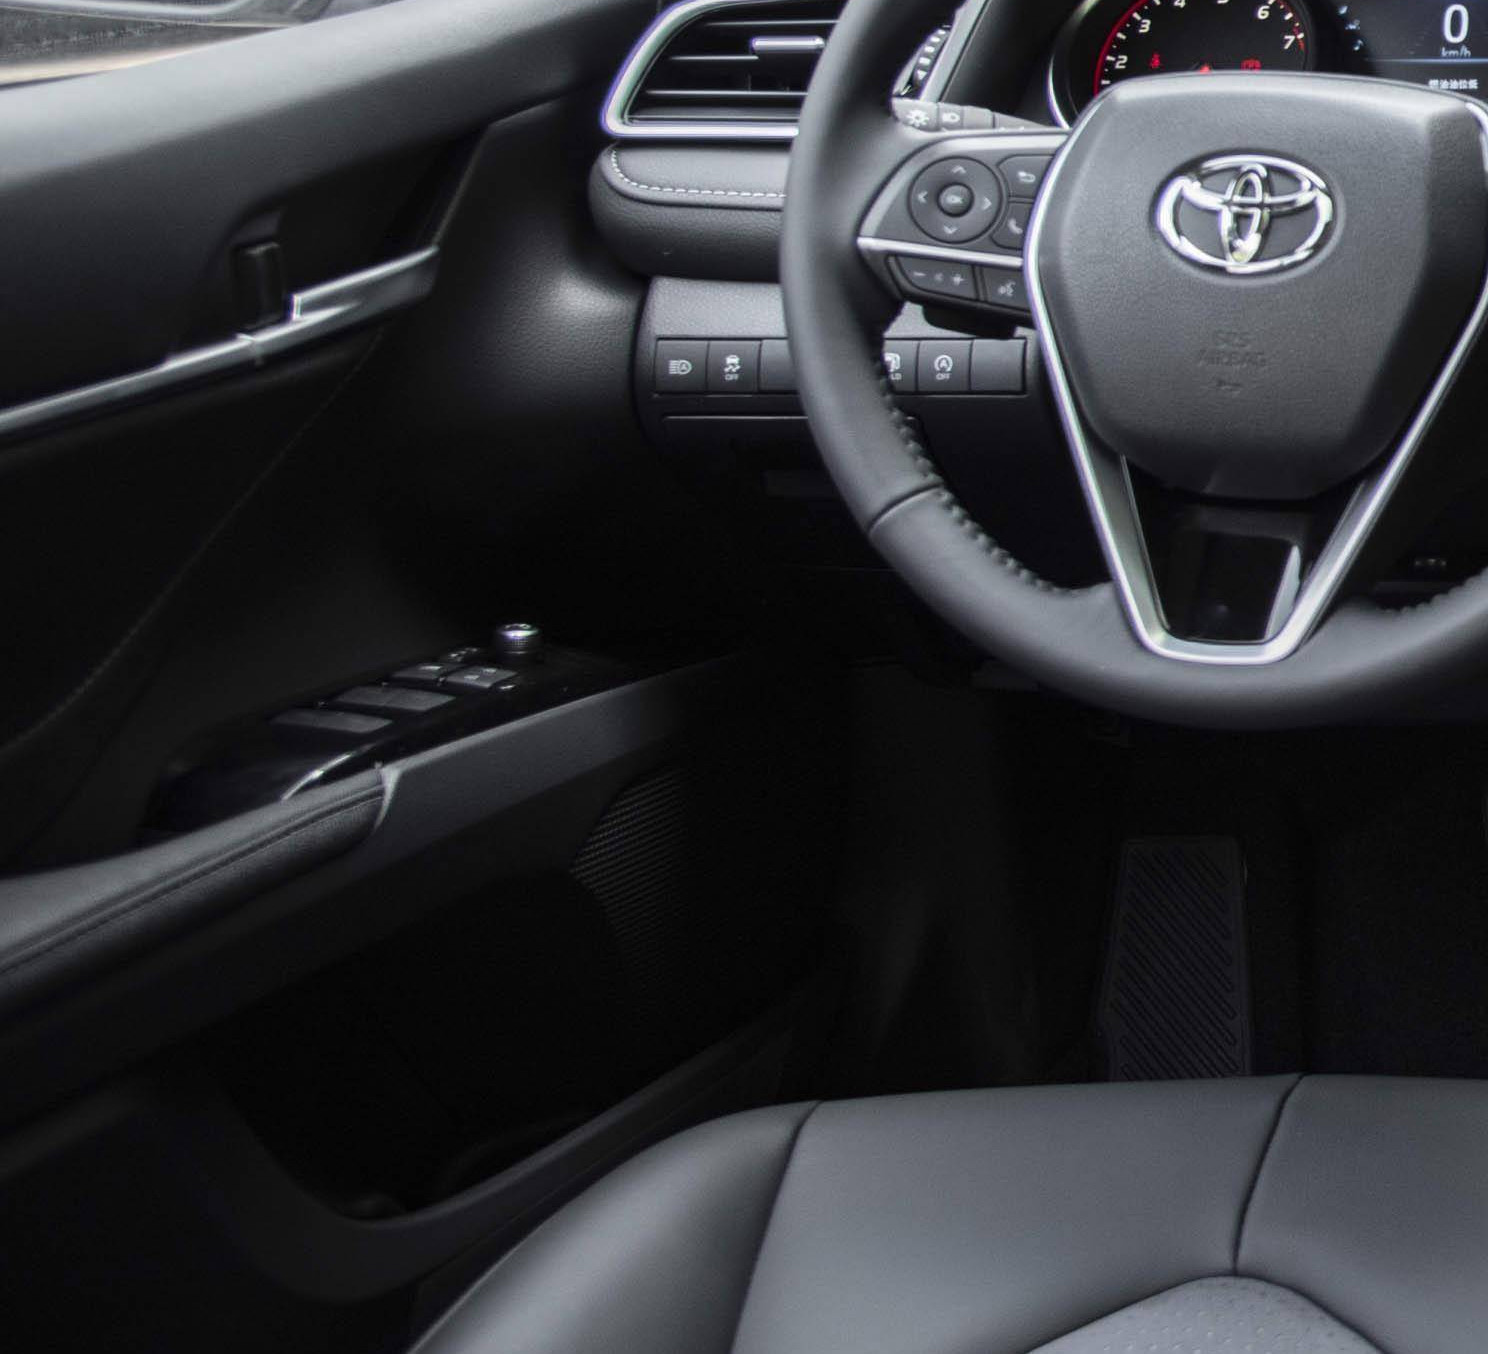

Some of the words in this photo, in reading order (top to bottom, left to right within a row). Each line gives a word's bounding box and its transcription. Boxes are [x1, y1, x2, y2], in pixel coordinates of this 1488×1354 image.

[1257, 5, 1270, 20] 6
[1138, 19, 1151, 33] 3
[1443, 3, 1469, 44] 0
[1284, 35, 1296, 50] 7
[1441, 47, 1471, 58] km/h
[1114, 55, 1128, 70] 2
[724, 373, 739, 381] OFF
[935, 373, 951, 381] OFF
